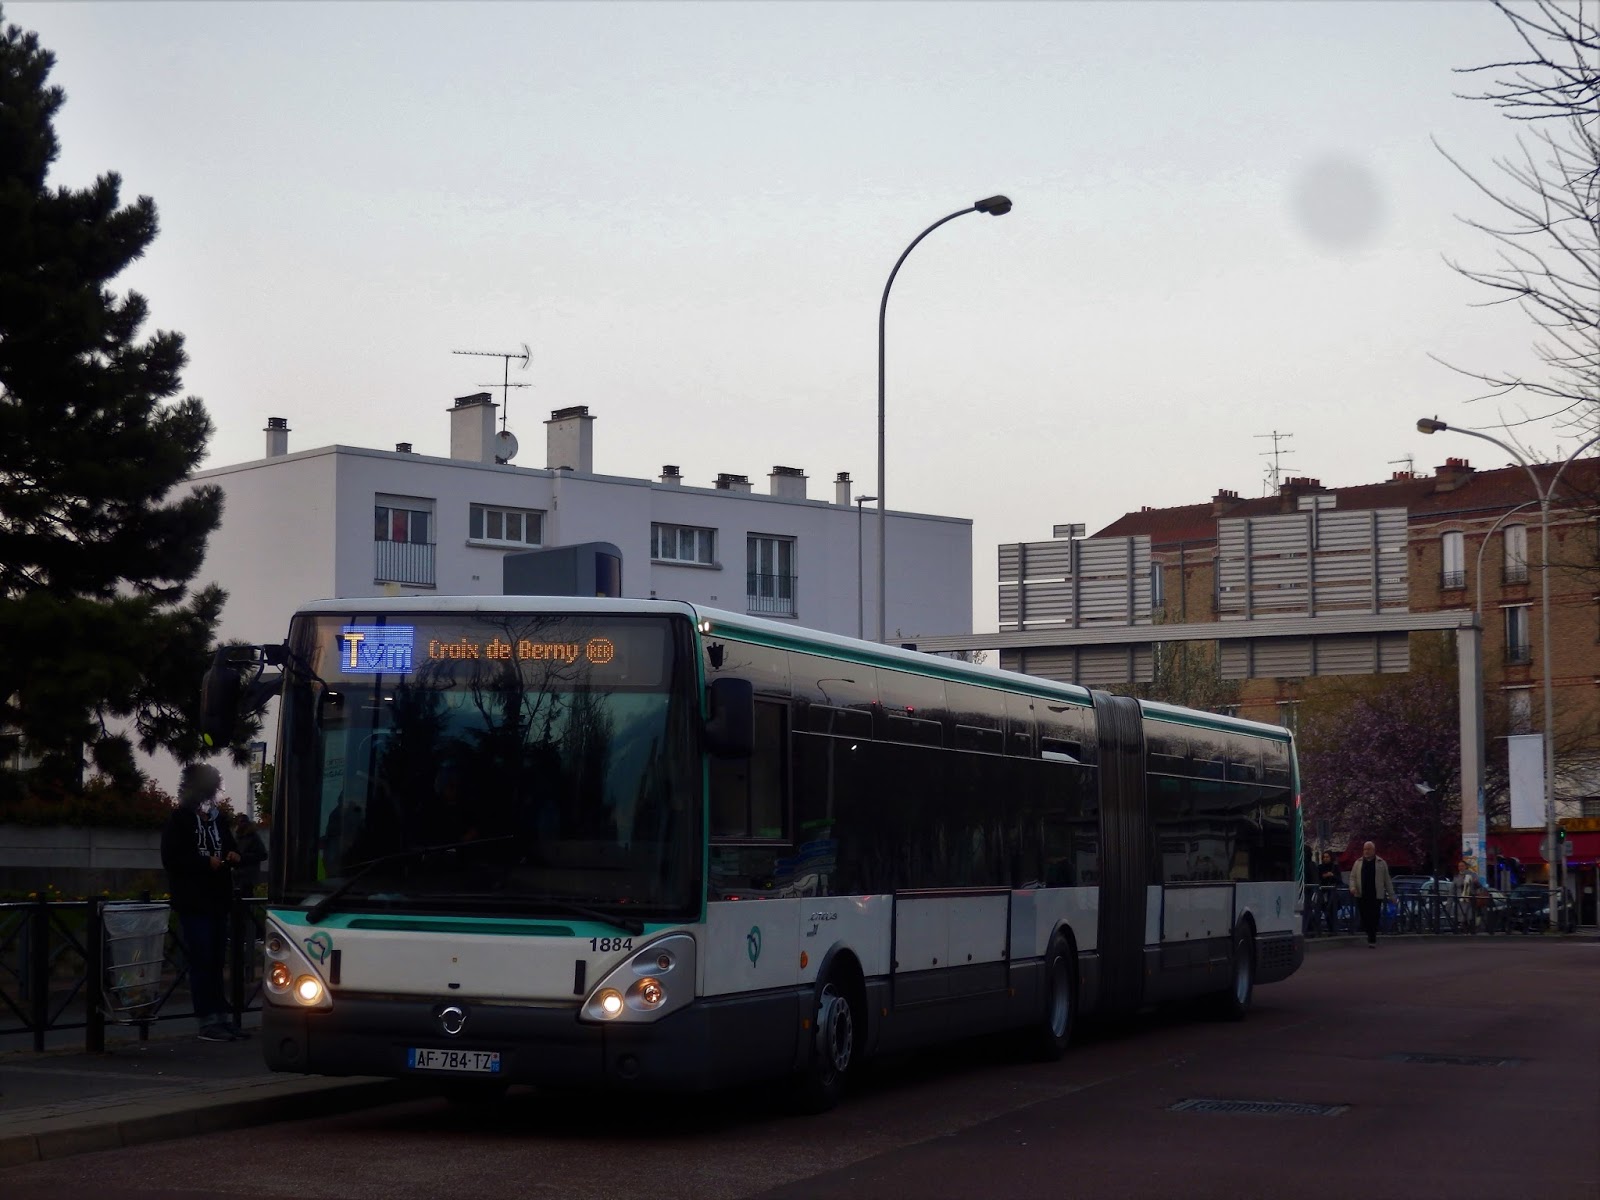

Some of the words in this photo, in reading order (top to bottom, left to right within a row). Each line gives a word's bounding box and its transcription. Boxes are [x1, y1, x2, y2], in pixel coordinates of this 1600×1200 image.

[429, 638, 479, 659] Croix
[486, 638, 511, 659] de
[518, 640, 578, 663] Berny
[589, 937, 633, 952] 1884
